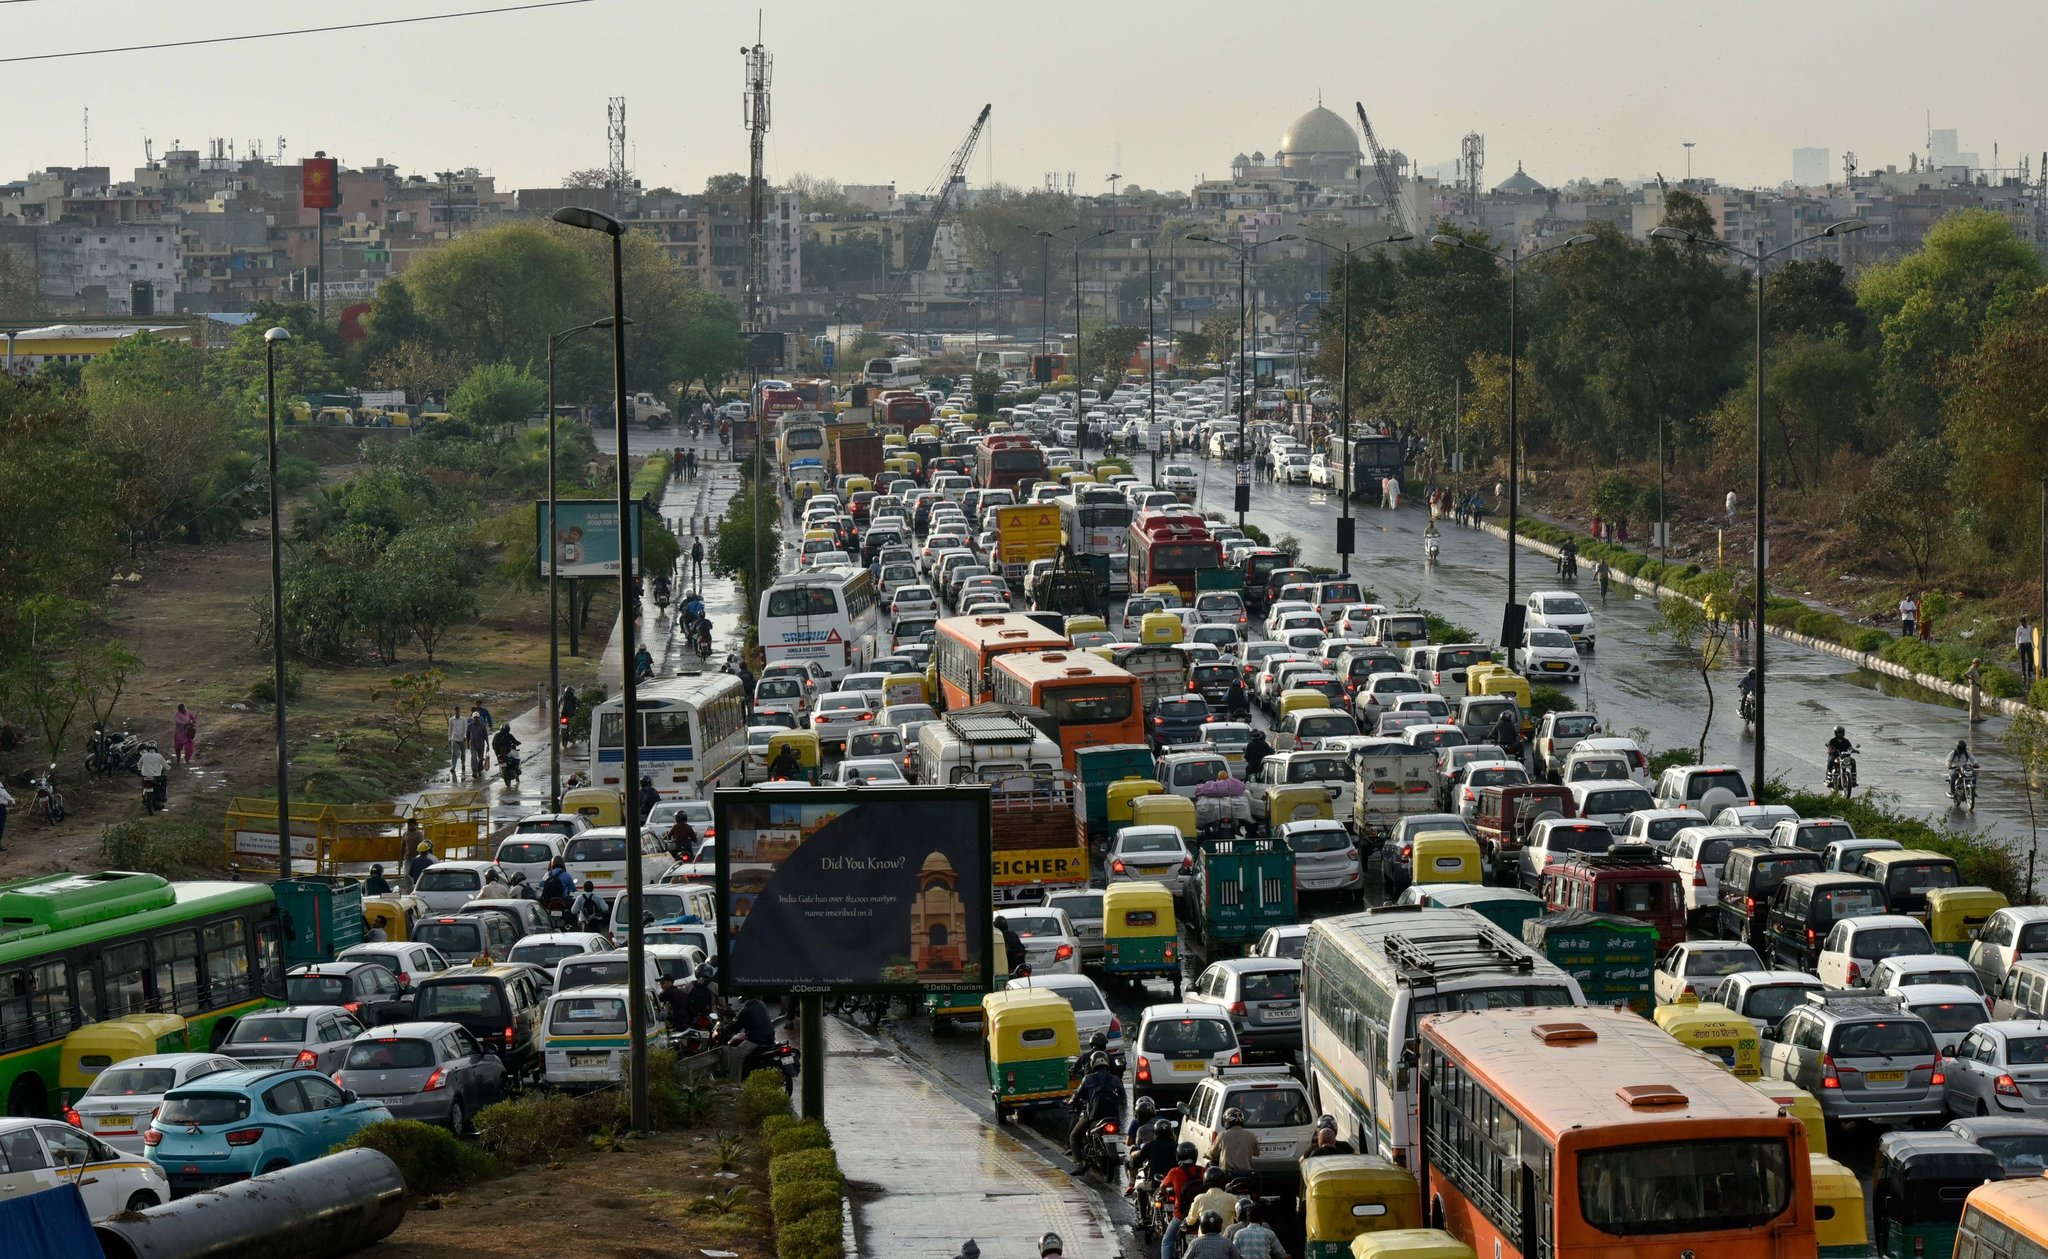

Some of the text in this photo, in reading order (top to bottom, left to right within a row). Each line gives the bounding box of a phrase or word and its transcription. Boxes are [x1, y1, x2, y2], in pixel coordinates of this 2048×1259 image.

[821, 855, 906, 870] Did You Know?
[992, 858, 1067, 875] EICHER
[778, 894, 797, 903] India
[797, 895, 814, 903] Gate
[815, 894, 828, 903] has
[869, 895, 897, 905] martyrs
[825, 907, 856, 917] inscribed
[790, 984, 831, 992] JCDecaux
[930, 983, 984, 991] Delhi Tourism
[1738, 1039, 1755, 1050] 1682
[1325, 1243, 1338, 1253] CNG
